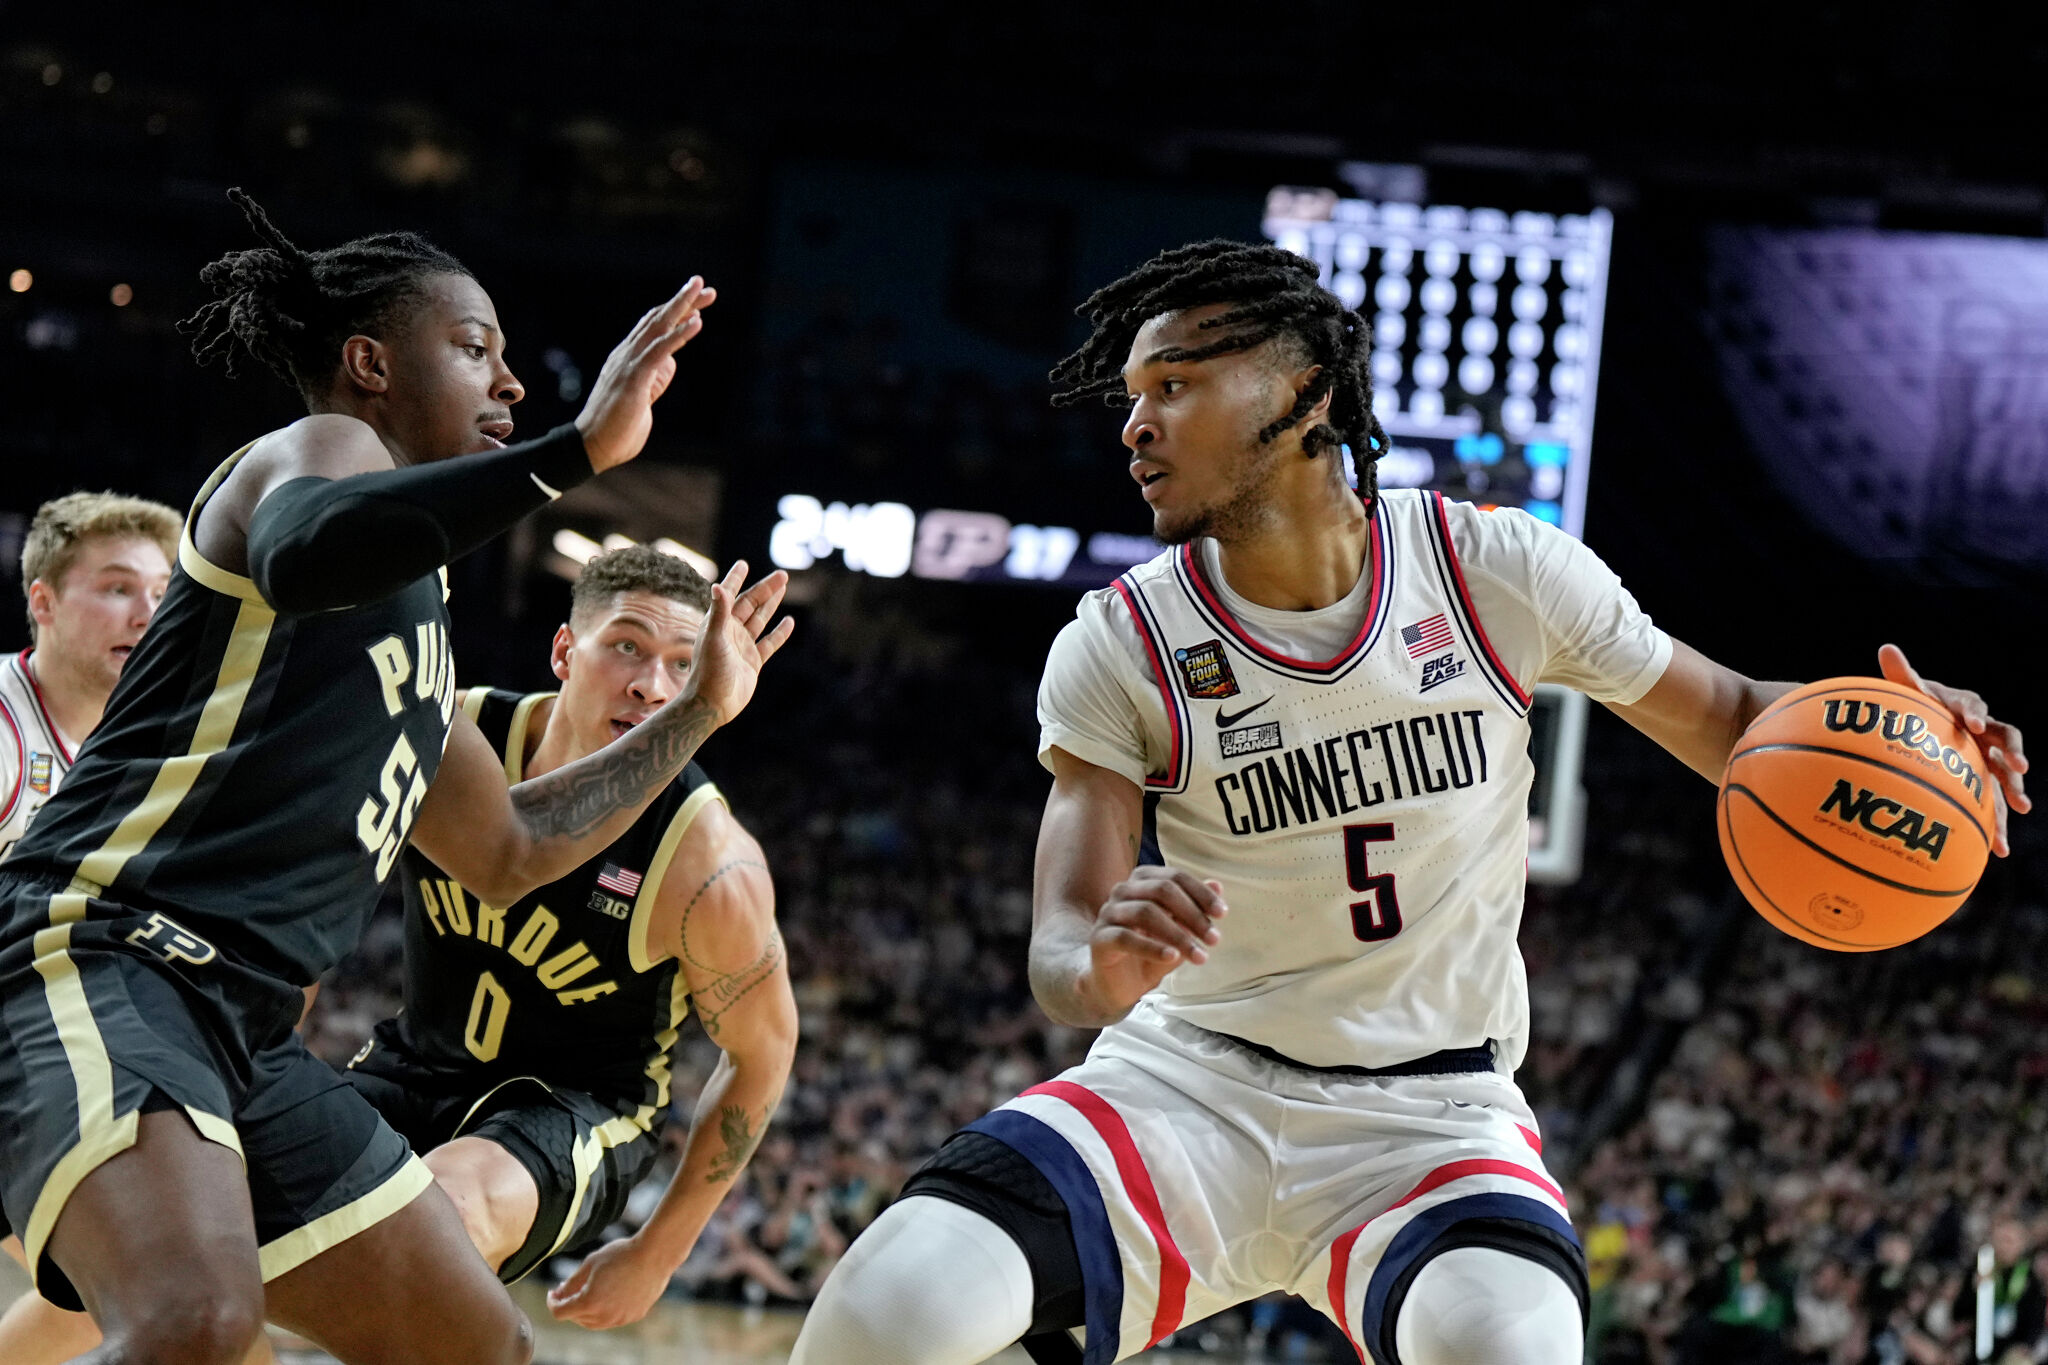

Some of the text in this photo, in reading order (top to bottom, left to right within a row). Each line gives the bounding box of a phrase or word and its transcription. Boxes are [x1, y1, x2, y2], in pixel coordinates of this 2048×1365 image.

[1185, 651, 1217, 672] FINAL
[1190, 663, 1221, 684] FOUR
[1421, 659, 1466, 687] EAST
[1423, 652, 1454, 675] BIG
[1215, 710, 1488, 836] CONNECTICUT
[1223, 736, 1280, 756] CHANGE
[1823, 699, 1984, 804] Wilson
[1818, 778, 1951, 863] NCAA
[1868, 839, 1904, 858] GAME
[1343, 822, 1403, 942] 5
[420, 878, 619, 1006] PURDUE
[464, 970, 511, 1063] 0
